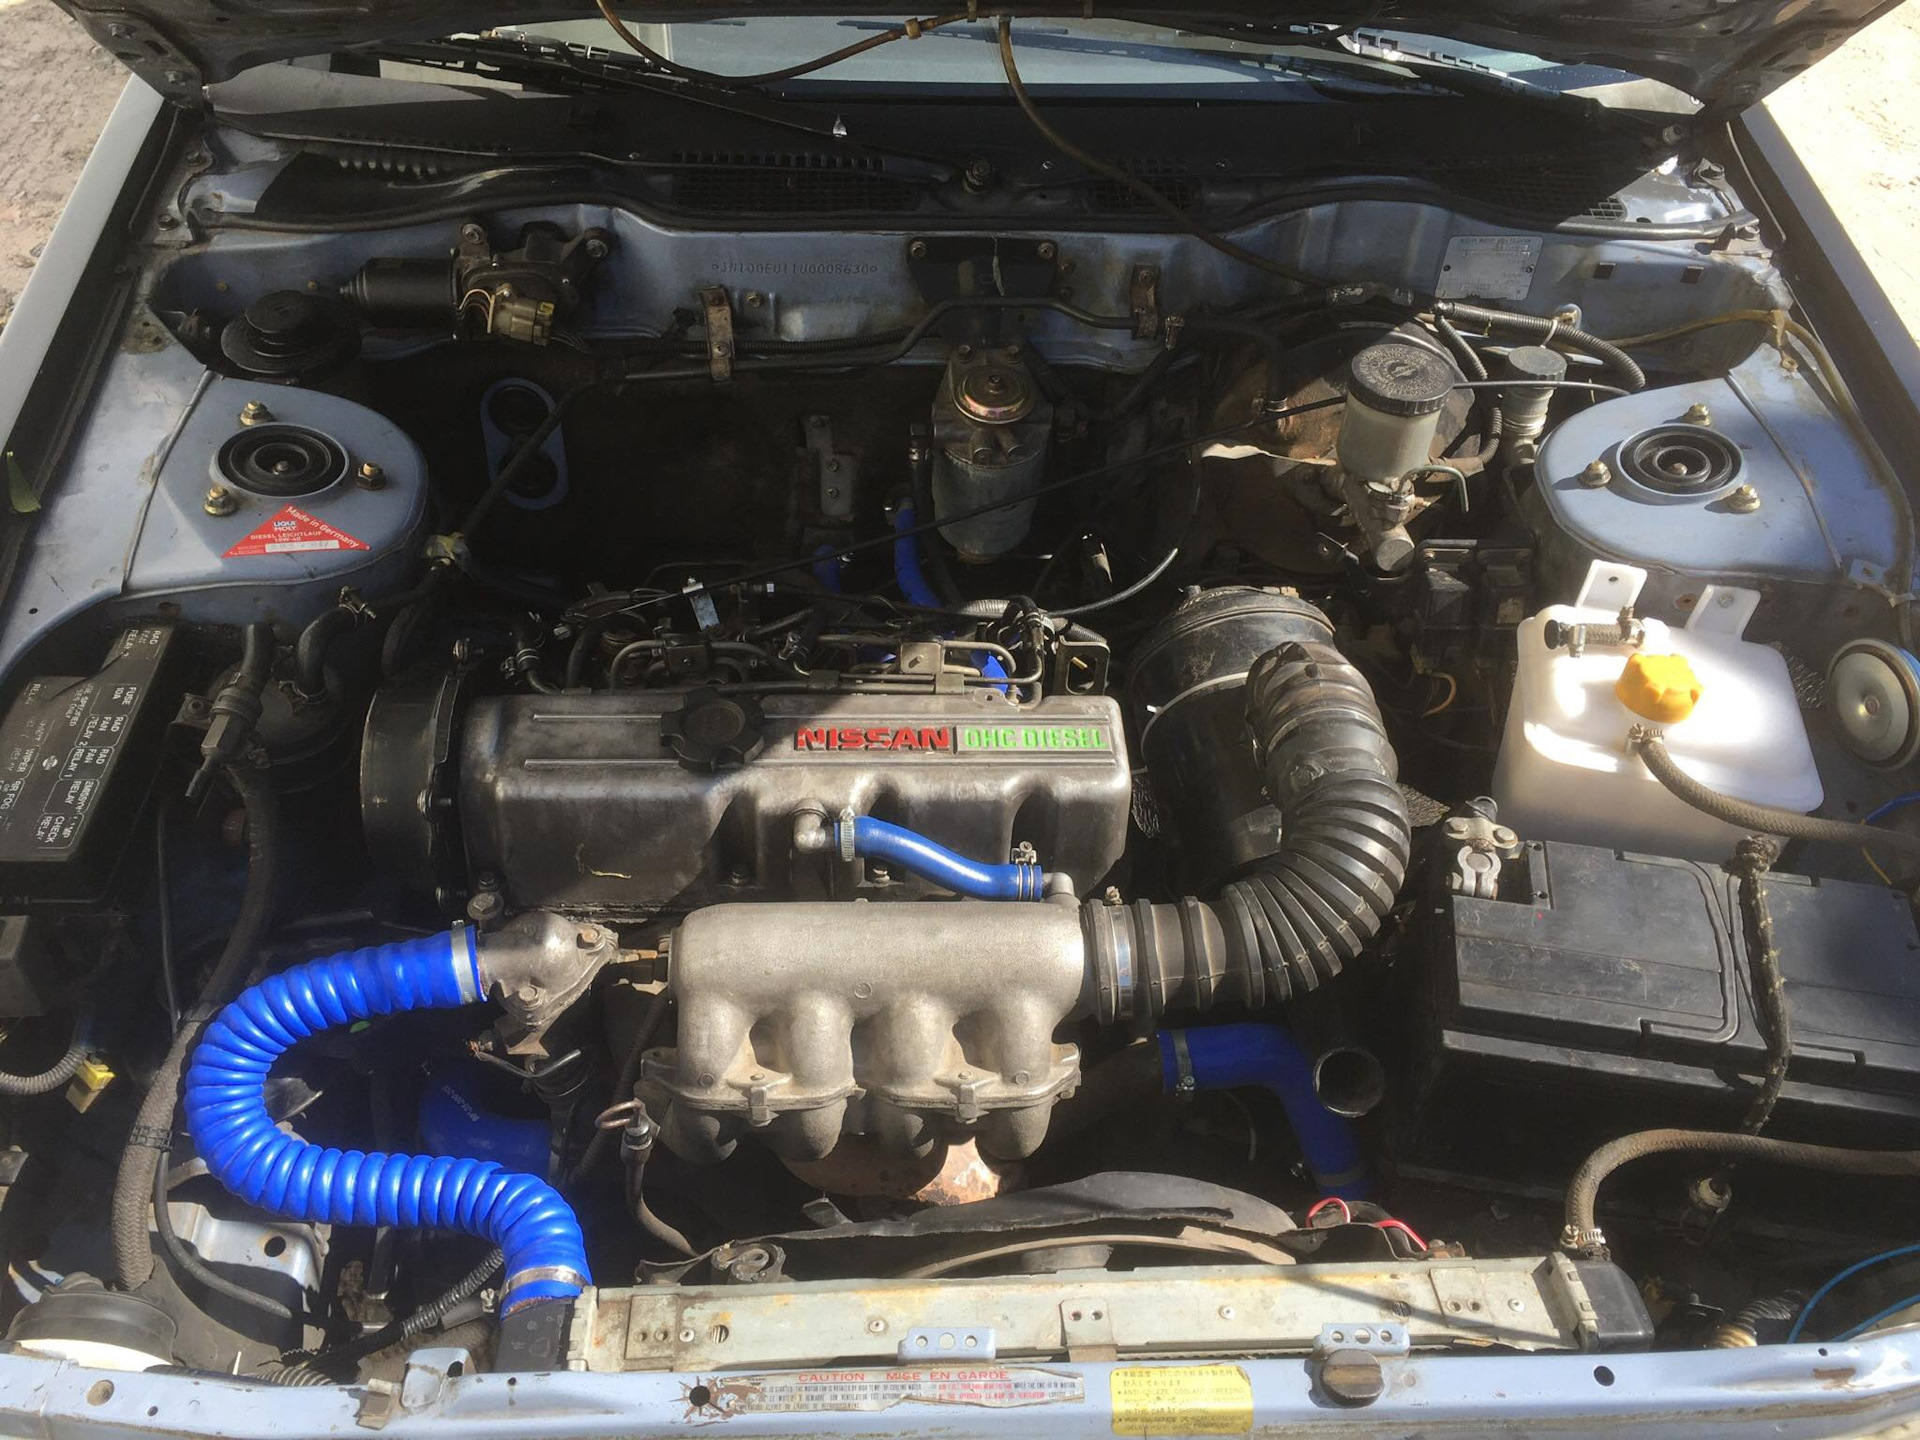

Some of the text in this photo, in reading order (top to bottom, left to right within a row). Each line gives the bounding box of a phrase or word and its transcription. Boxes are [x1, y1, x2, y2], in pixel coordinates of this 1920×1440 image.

[277, 531, 323, 539] LEICHTLAUF
[286, 506, 310, 523] Made
[310, 518, 320, 528] in
[319, 524, 359, 548] Germany
[149, 630, 161, 645] RAD
[112, 687, 124, 700] 10A
[121, 686, 137, 705] FUSE
[84, 716, 100, 739] RELAY
[98, 716, 112, 731] FAN
[110, 716, 124, 732] RAD
[795, 728, 1108, 749] NISSAN OHC DIESEL
[16, 749, 35, 773] WIPER
[68, 749, 85, 772] RELAY
[84, 749, 97, 764] FAN
[96, 749, 109, 765] RAD
[0, 793, 15, 810] FOG
[65, 781, 82, 805] RELAY
[45, 816, 65, 843] CHECK
[798, 1371, 1008, 1382] CAUTION MISE EN GARDE
